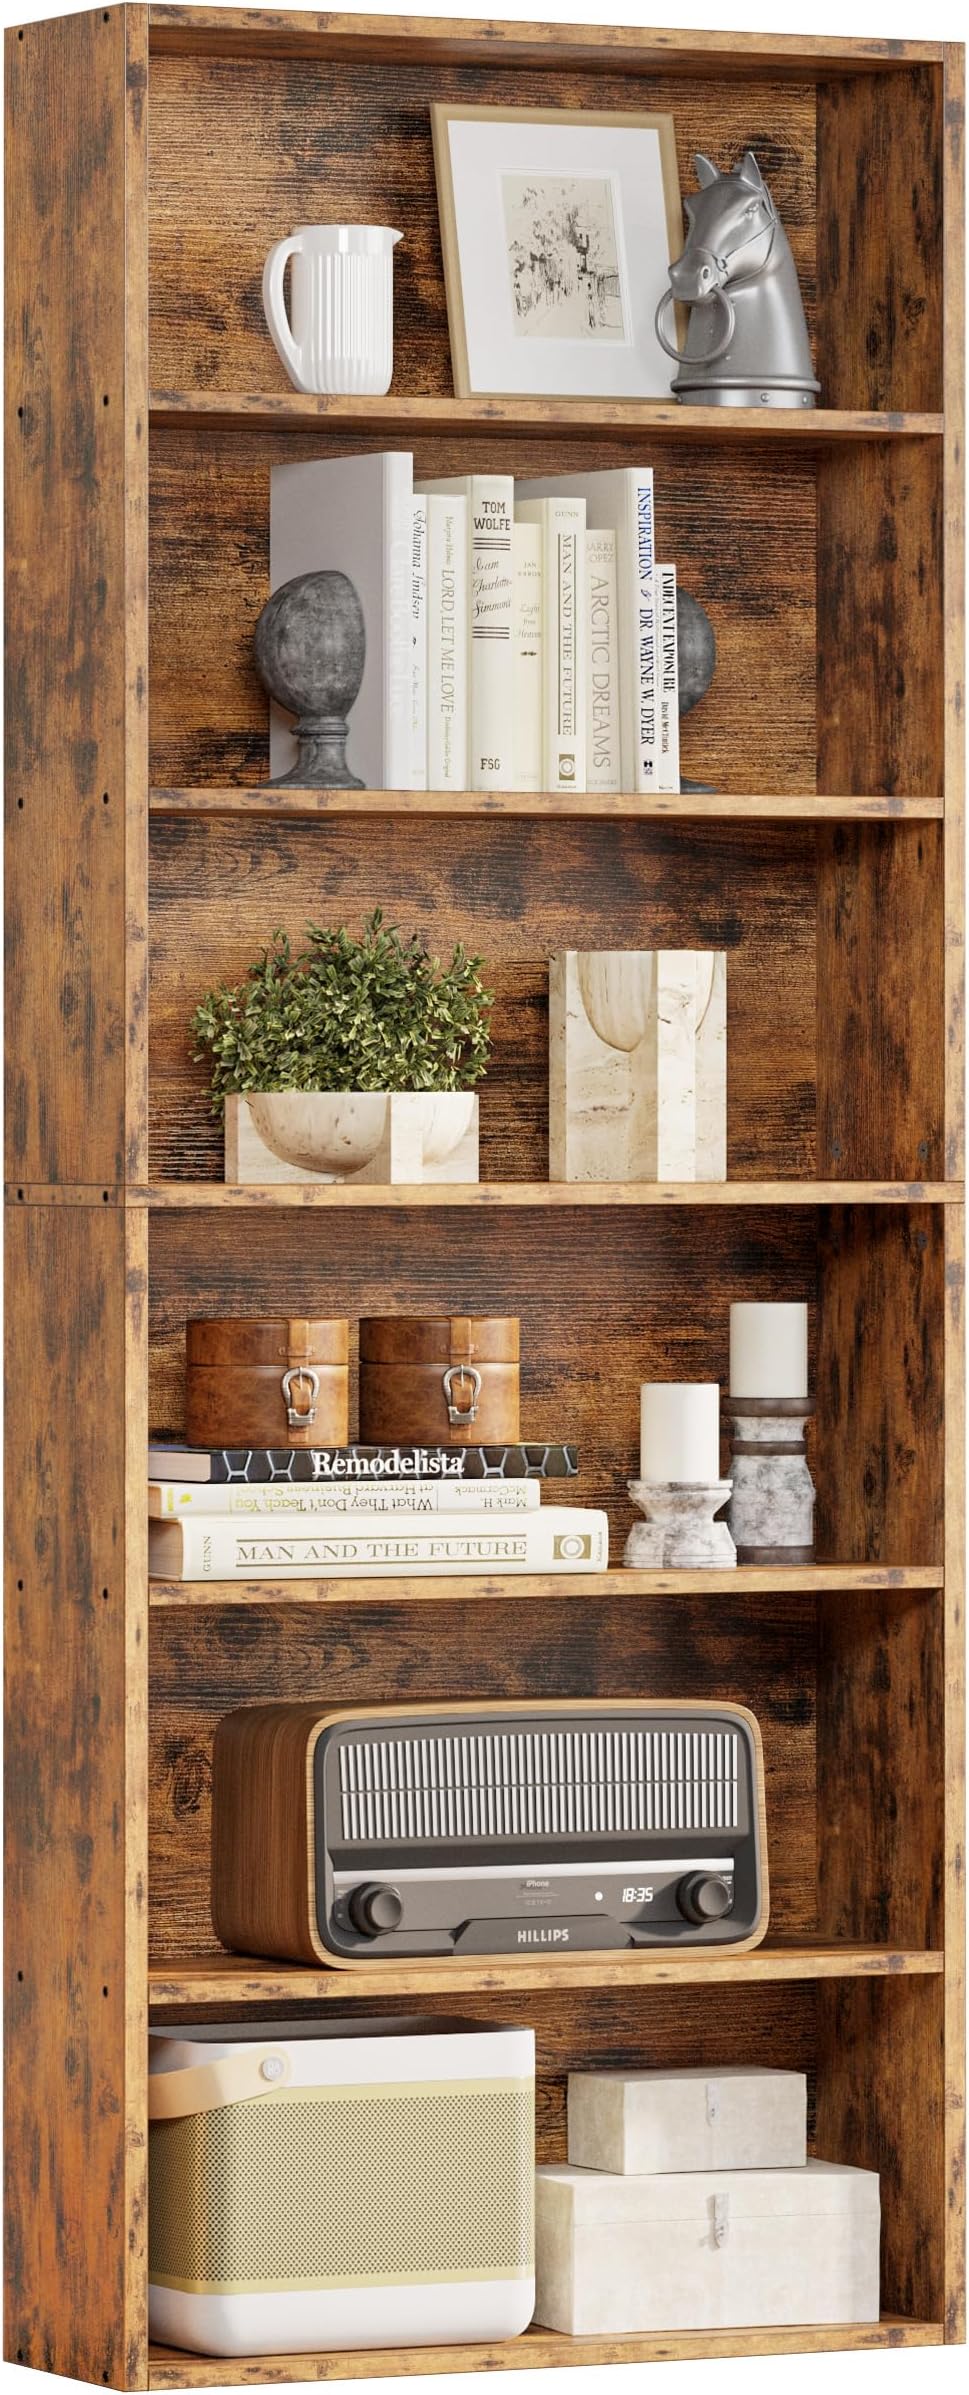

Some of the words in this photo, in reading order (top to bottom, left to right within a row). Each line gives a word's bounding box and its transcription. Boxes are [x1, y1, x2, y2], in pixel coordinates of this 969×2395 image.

[481, 501, 506, 514] TOM
[473, 517, 511, 531] WOLFE
[637, 487, 653, 581] INSPIRATION
[562, 534, 573, 574] MAN
[562, 580, 573, 618] AND
[440, 616, 455, 646] LET
[590, 576, 610, 665] ARCTIC
[639, 608, 653, 632] DR.
[562, 623, 573, 661] THE
[440, 647, 455, 671] ME
[640, 636, 654, 685] WAYNE
[440, 674, 455, 713] LOVE
[562, 667, 573, 736] FUTURE
[641, 689, 654, 704] W.
[591, 673, 611, 768] DREAMS
[641, 708, 655, 745] DYER
[480, 757, 500, 770] FSG
[312, 1448, 465, 1475] Remodelista
[265, 1498, 307, 1511] Teach
[350, 1495, 389, 1511] They
[391, 1498, 433, 1511] What
[496, 1497, 527, 1508] Mark
[202, 1536, 212, 1572] GUNN
[237, 1545, 296, 1561] MAN
[303, 1544, 358, 1559] AND
[366, 1542, 419, 1557] THE
[429, 1541, 527, 1557] FUTURE
[526, 1879, 550, 1888] iPhone
[621, 1887, 654, 1903] 18:35
[517, 1928, 570, 1944] HILLIPS
